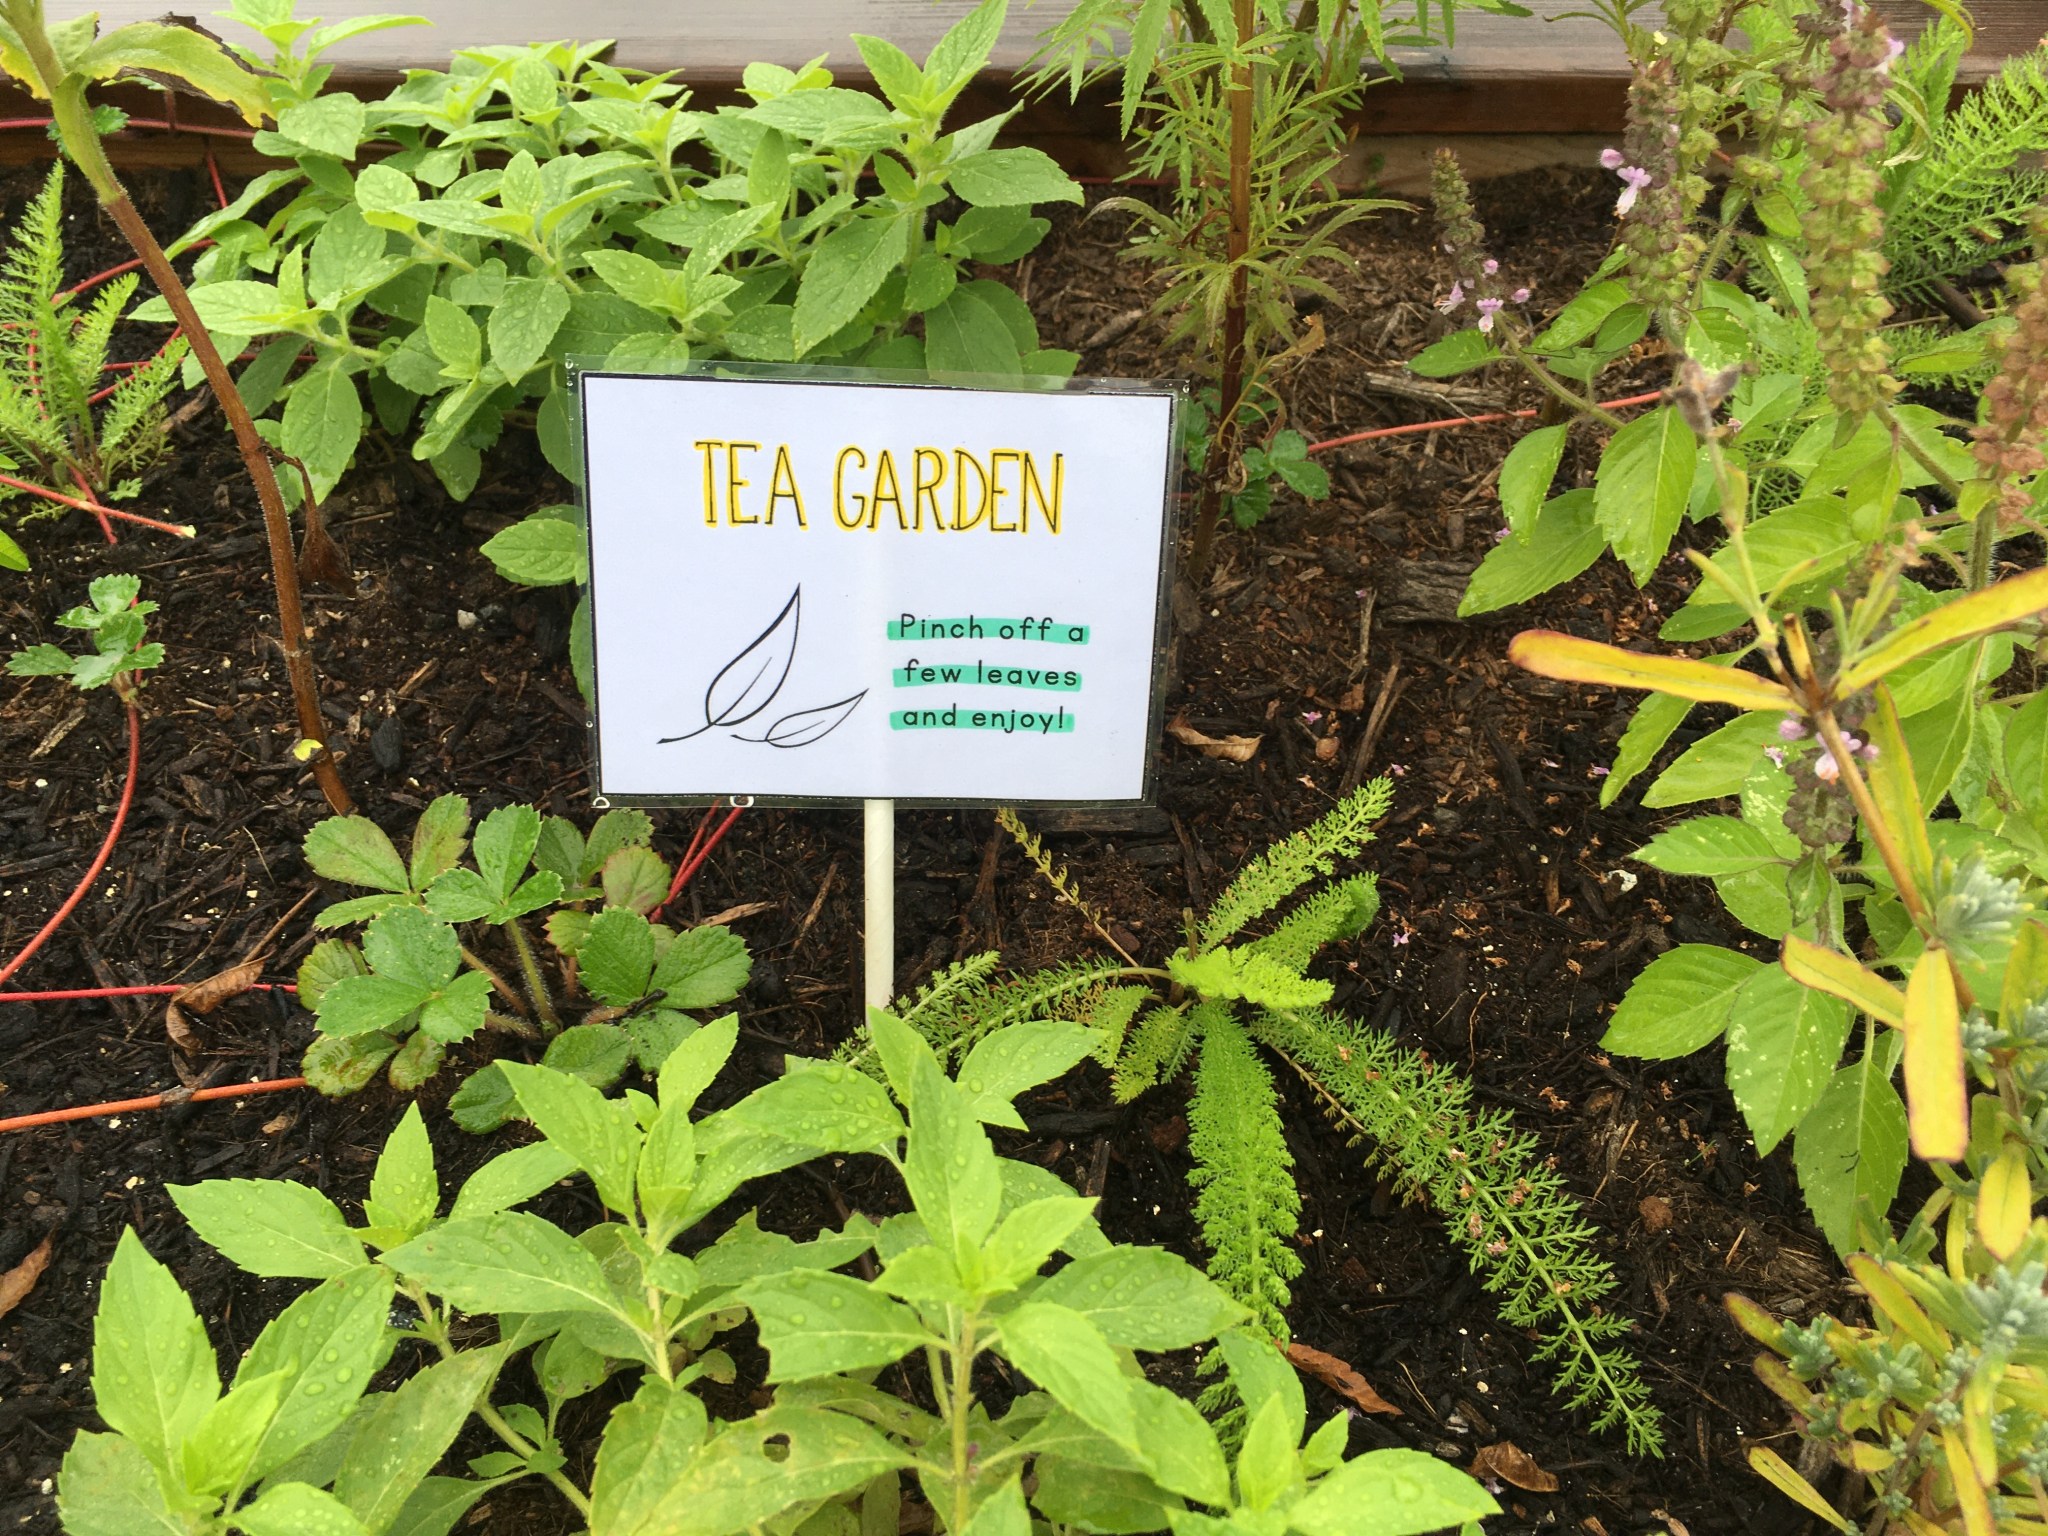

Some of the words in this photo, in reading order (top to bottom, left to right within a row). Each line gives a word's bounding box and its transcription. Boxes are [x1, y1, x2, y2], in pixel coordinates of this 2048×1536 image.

[695, 440, 808, 530] TEA
[832, 445, 1064, 533] GARDEN
[900, 613, 983, 639] Pinch
[999, 616, 1053, 640] off
[1068, 626, 1084, 642] a
[904, 658, 962, 682] few
[978, 660, 1077, 686] leaves
[903, 702, 957, 726] and
[972, 705, 1063, 734] enjoy!
